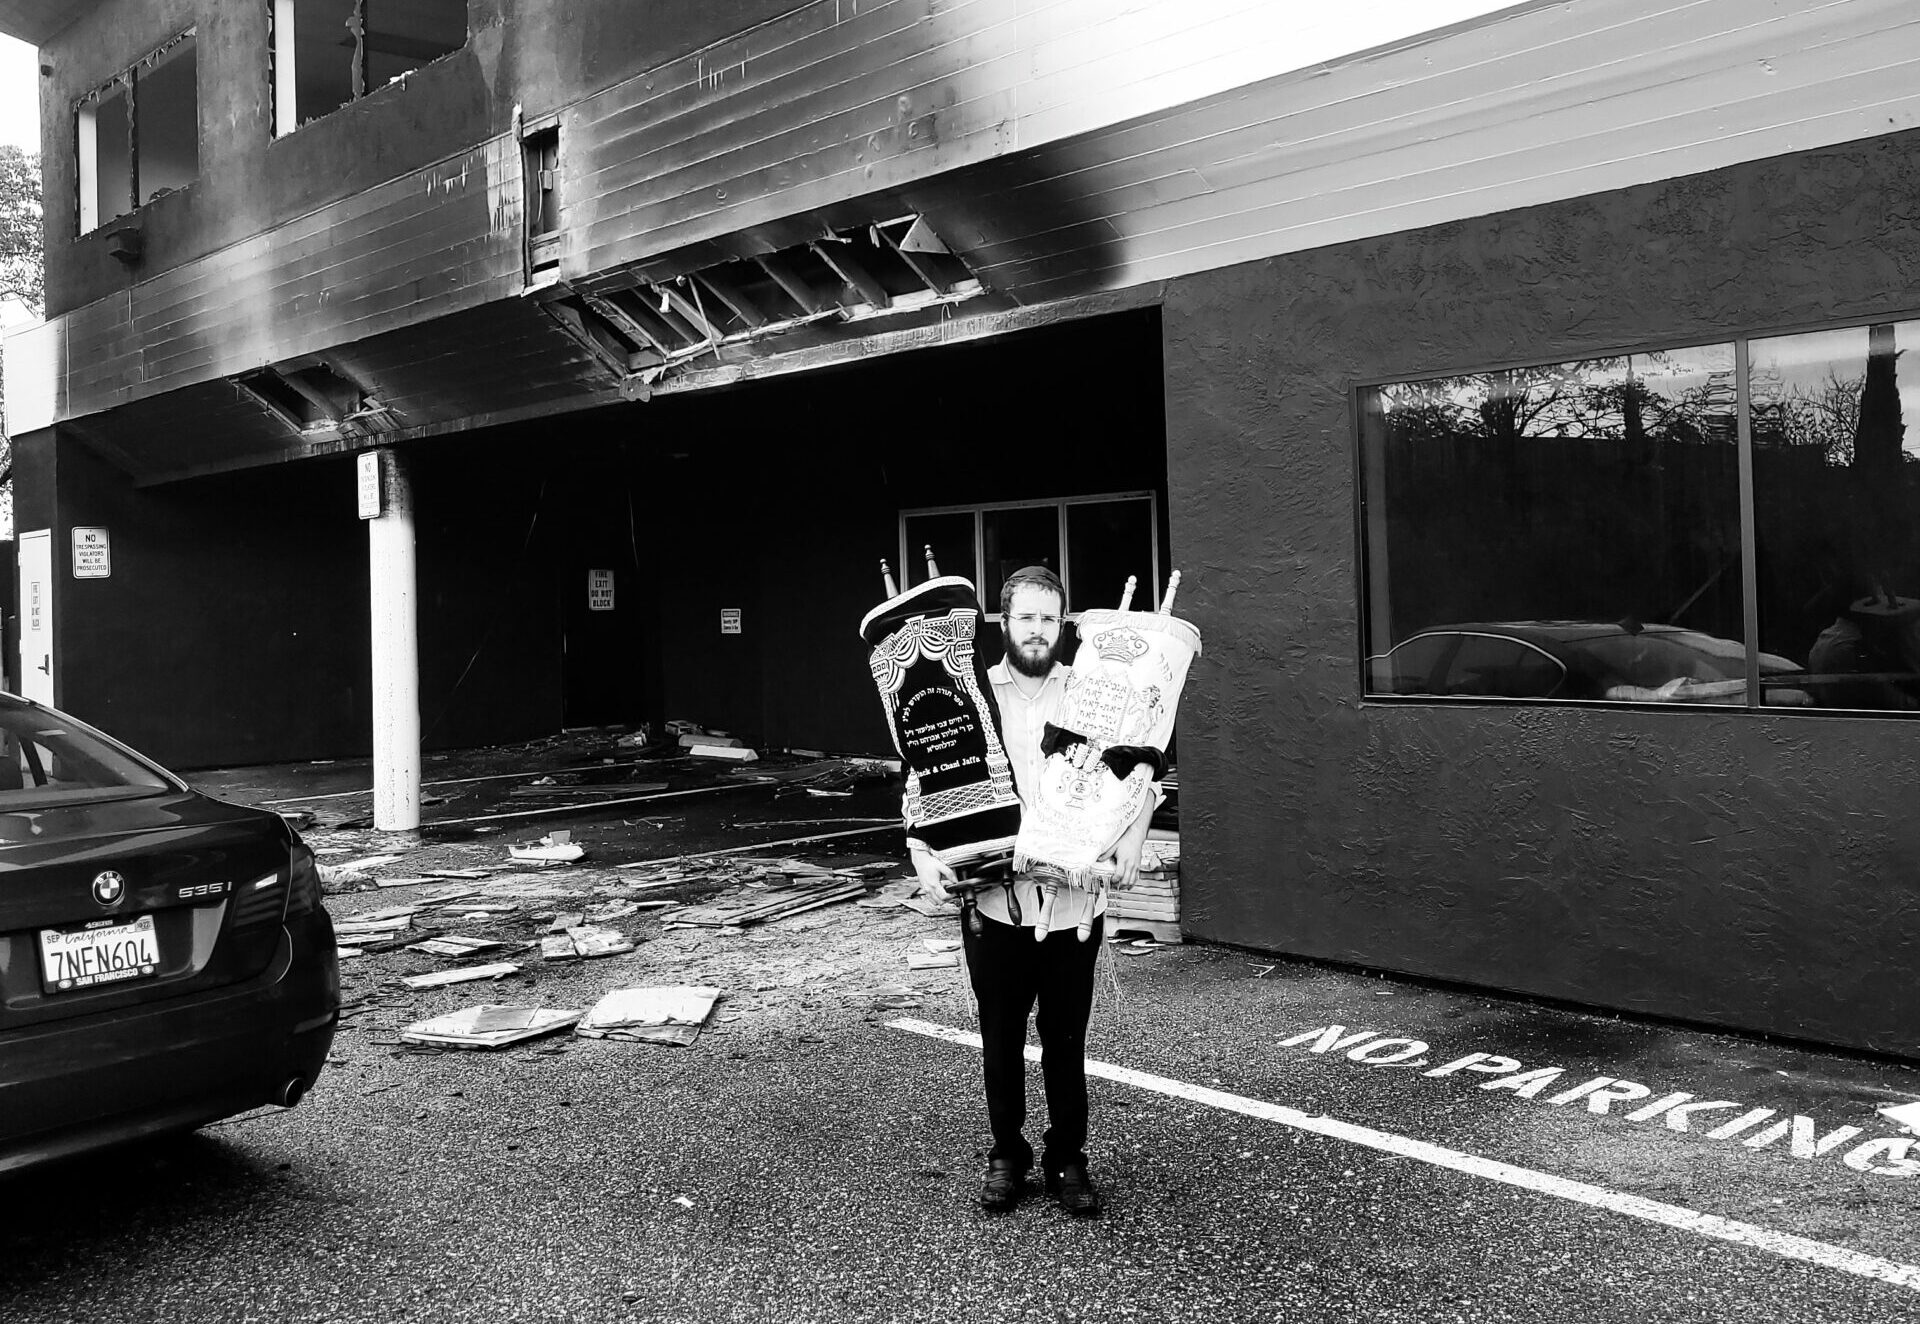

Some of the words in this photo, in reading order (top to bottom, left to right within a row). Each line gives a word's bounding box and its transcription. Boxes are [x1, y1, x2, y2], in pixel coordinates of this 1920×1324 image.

[85, 534, 96, 543] NO
[595, 580, 608, 588] EXIT
[593, 599, 611, 607] BLOCK
[940, 759, 960, 771] Chani
[962, 755, 981, 766] Jaffa
[46, 934, 60, 944] SEP
[65, 926, 130, 945] California
[50, 938, 153, 980] 7NFN604
[76, 976, 94, 986] SAN
[94, 968, 139, 983] FRANCISCO
[1277, 1025, 1429, 1067] NO
[1424, 1052, 1920, 1176] PARKING
